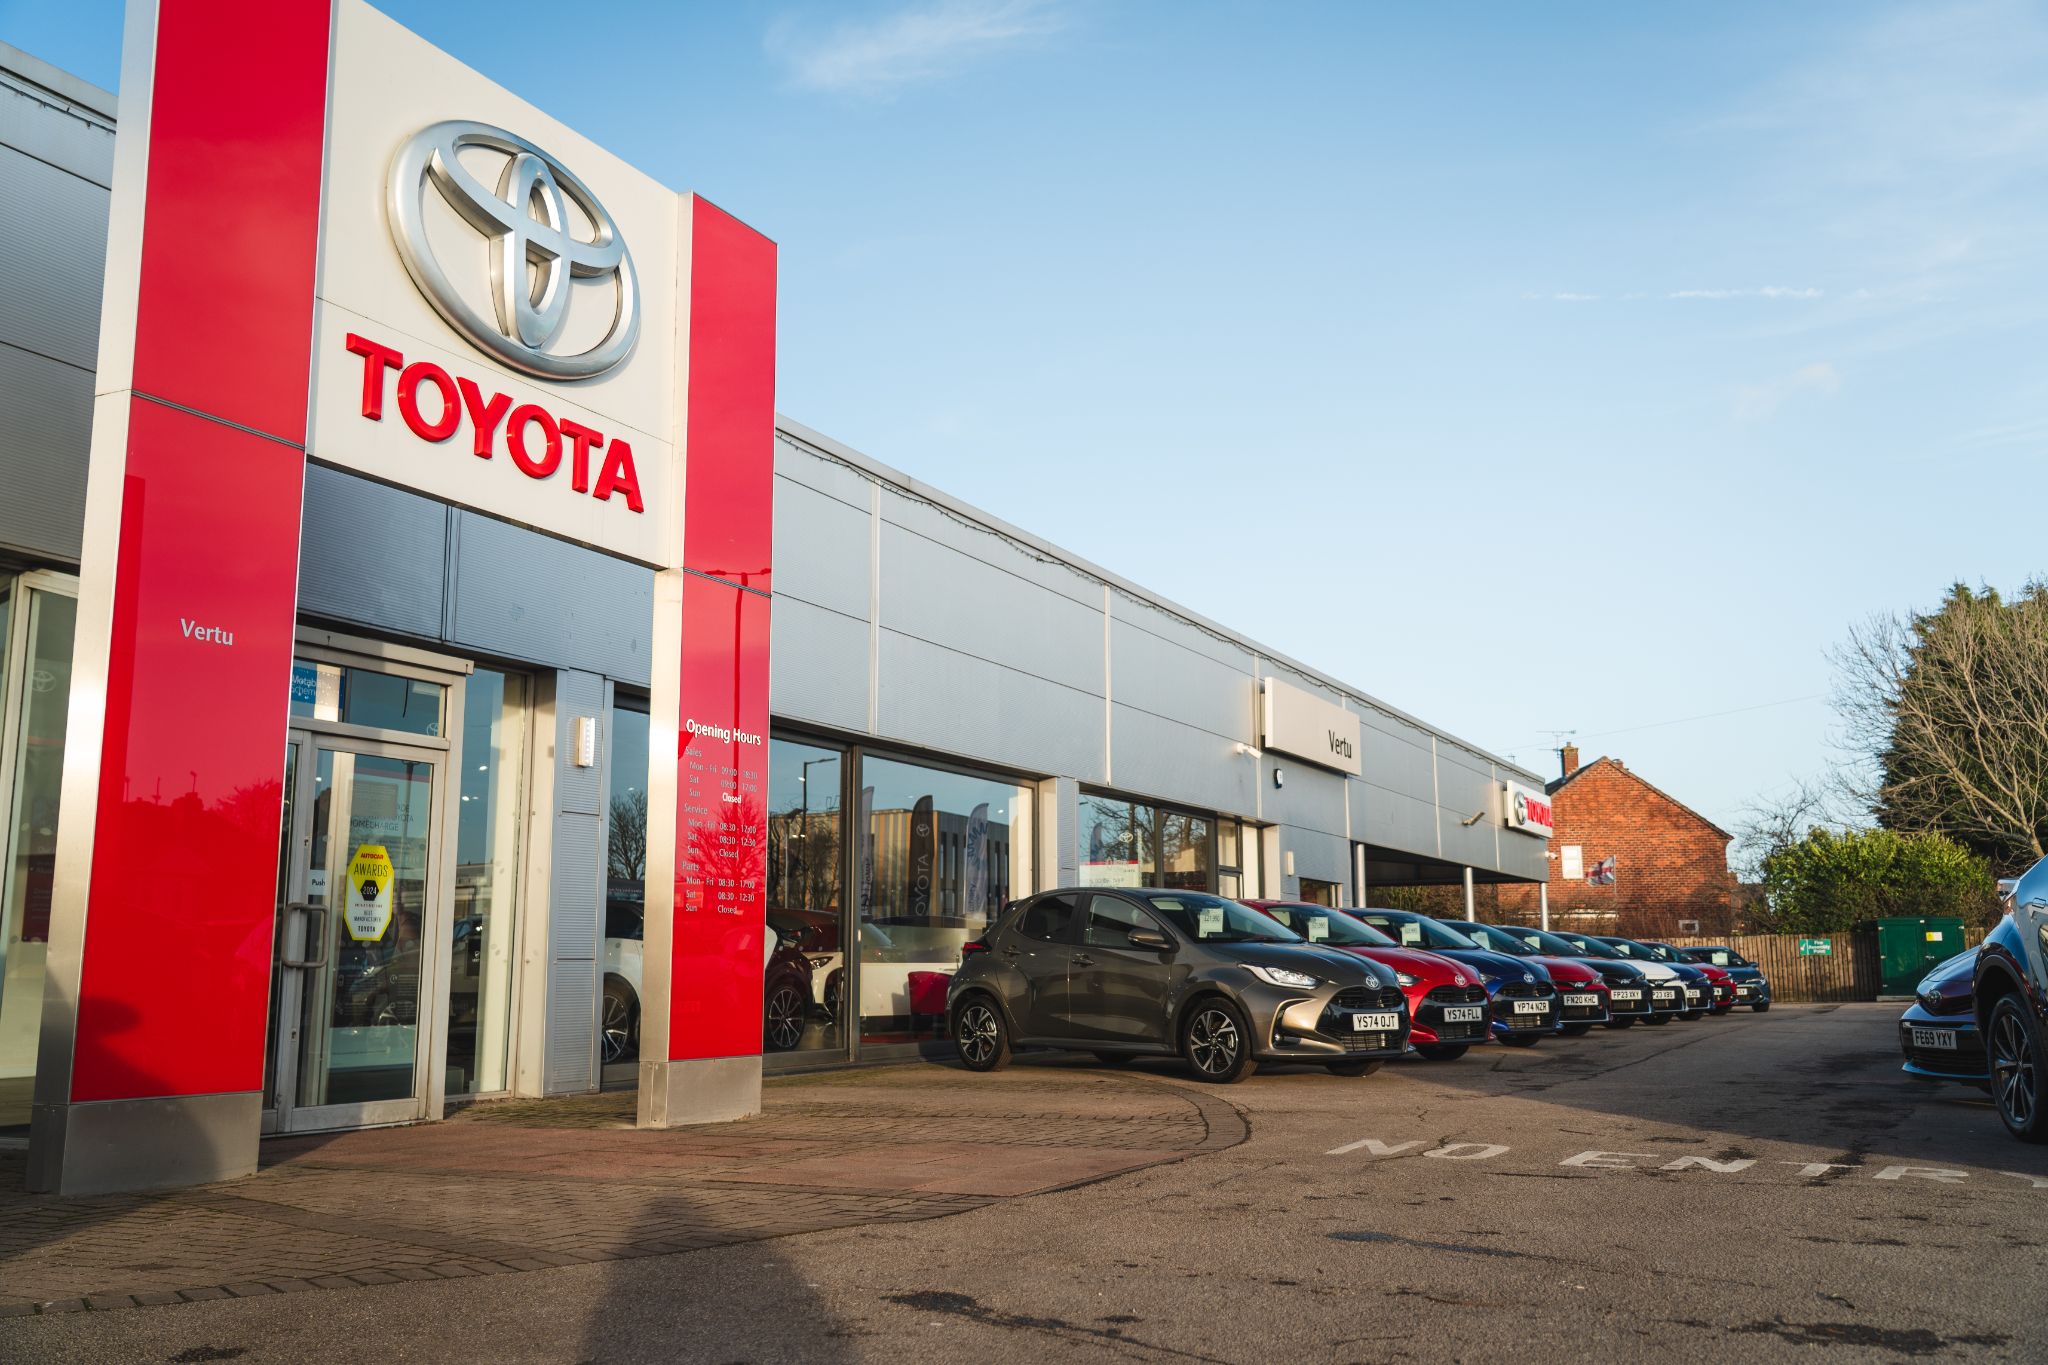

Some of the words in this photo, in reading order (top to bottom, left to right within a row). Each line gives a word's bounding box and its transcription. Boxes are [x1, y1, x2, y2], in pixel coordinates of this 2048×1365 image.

[346, 332, 644, 513] TOYOTA
[180, 618, 233, 646] Vertu
[686, 719, 730, 744] Opening
[734, 728, 761, 745] Hours
[1328, 729, 1352, 759] Vertu
[686, 746, 702, 757] Sales
[689, 761, 703, 771] Mon
[709, 764, 717, 773] Fri
[689, 774, 699, 784] Sat
[689, 788, 700, 797] Sun
[723, 792, 741, 804] Closed
[684, 803, 708, 815] Service
[688, 818, 702, 828] Mon
[707, 820, 715, 829] Fri
[719, 822, 735, 832] 08:30
[688, 832, 697, 841] Sat
[719, 836, 735, 845] 08:30
[741, 838, 756, 847] 12:30
[687, 845, 698, 855] Sun
[719, 848, 738, 858] Closed
[354, 863, 388, 877] AWARDS
[682, 861, 699, 871] Parts
[312, 878, 325, 887] Push
[686, 876, 700, 885] Mon
[706, 877, 714, 886] Fri
[719, 878, 734, 887] 08:30
[740, 879, 755, 889] 17:00
[916, 853, 929, 916] OYOTA
[362, 886, 377, 895] 2024
[686, 890, 696, 898] Sat
[718, 892, 734, 901] 08:30
[739, 893, 754, 902] 12:30
[686, 904, 697, 912] Sun
[718, 904, 737, 914] Closed
[1516, 1003, 1534, 1012] YP74
[1536, 1002, 1547, 1011] NZR
[1447, 1009, 1466, 1020] YS74
[1467, 1008, 1479, 1019] FLL
[1357, 1015, 1378, 1028] YS74
[1915, 1031, 1934, 1045] FE69
[1936, 1032, 1952, 1047] YXY
[1325, 1139, 1510, 1160] NO
